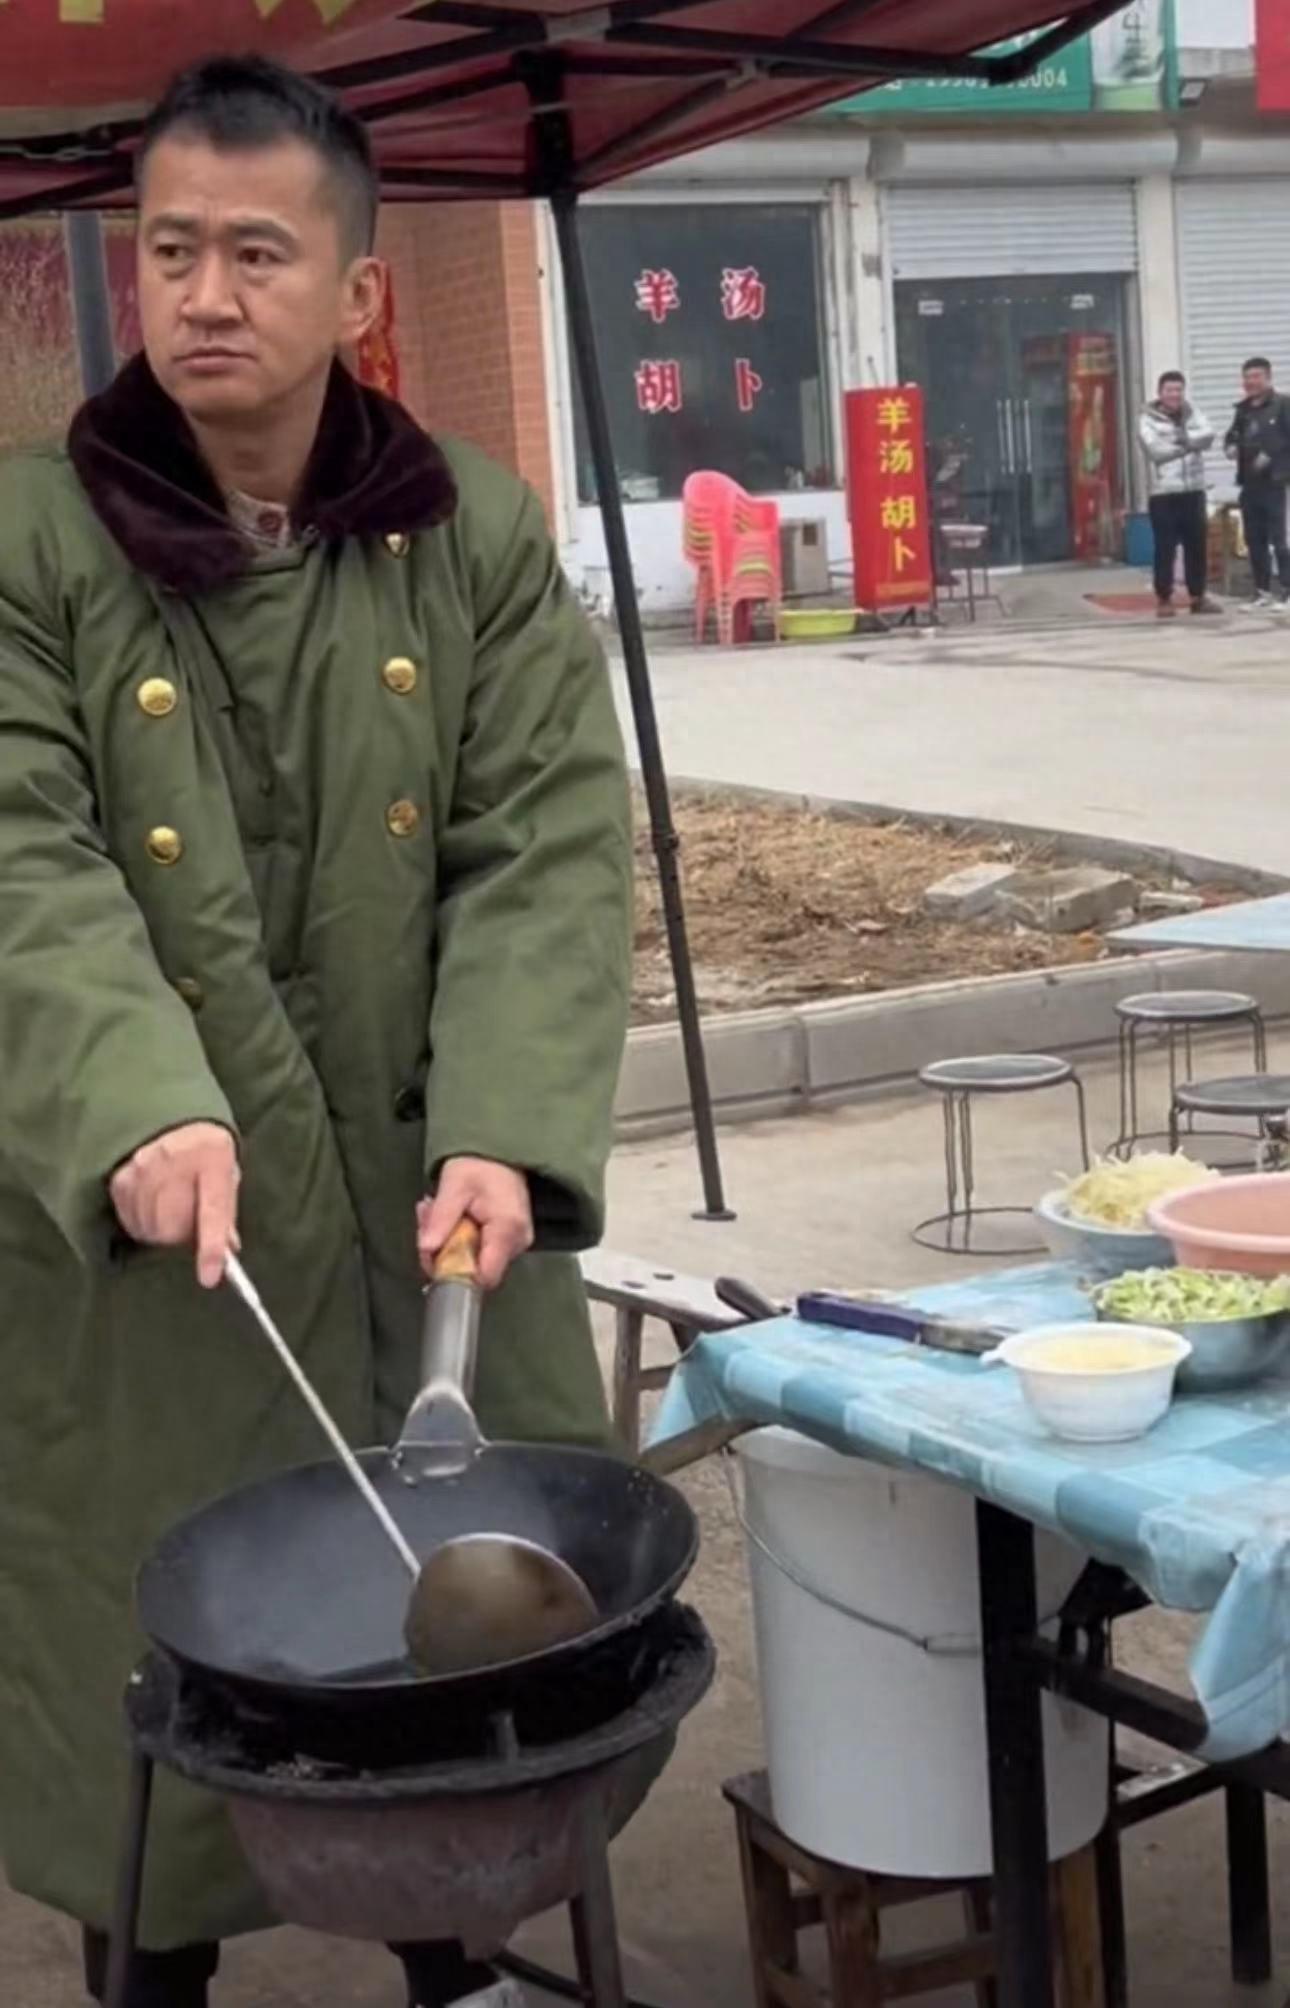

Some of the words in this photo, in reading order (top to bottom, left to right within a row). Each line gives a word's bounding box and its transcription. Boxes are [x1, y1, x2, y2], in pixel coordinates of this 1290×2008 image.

[634, 266, 766, 323] 羊汤
[634, 358, 763, 413] 胡卜
[876, 396, 917, 573] 羊汤胡卜
